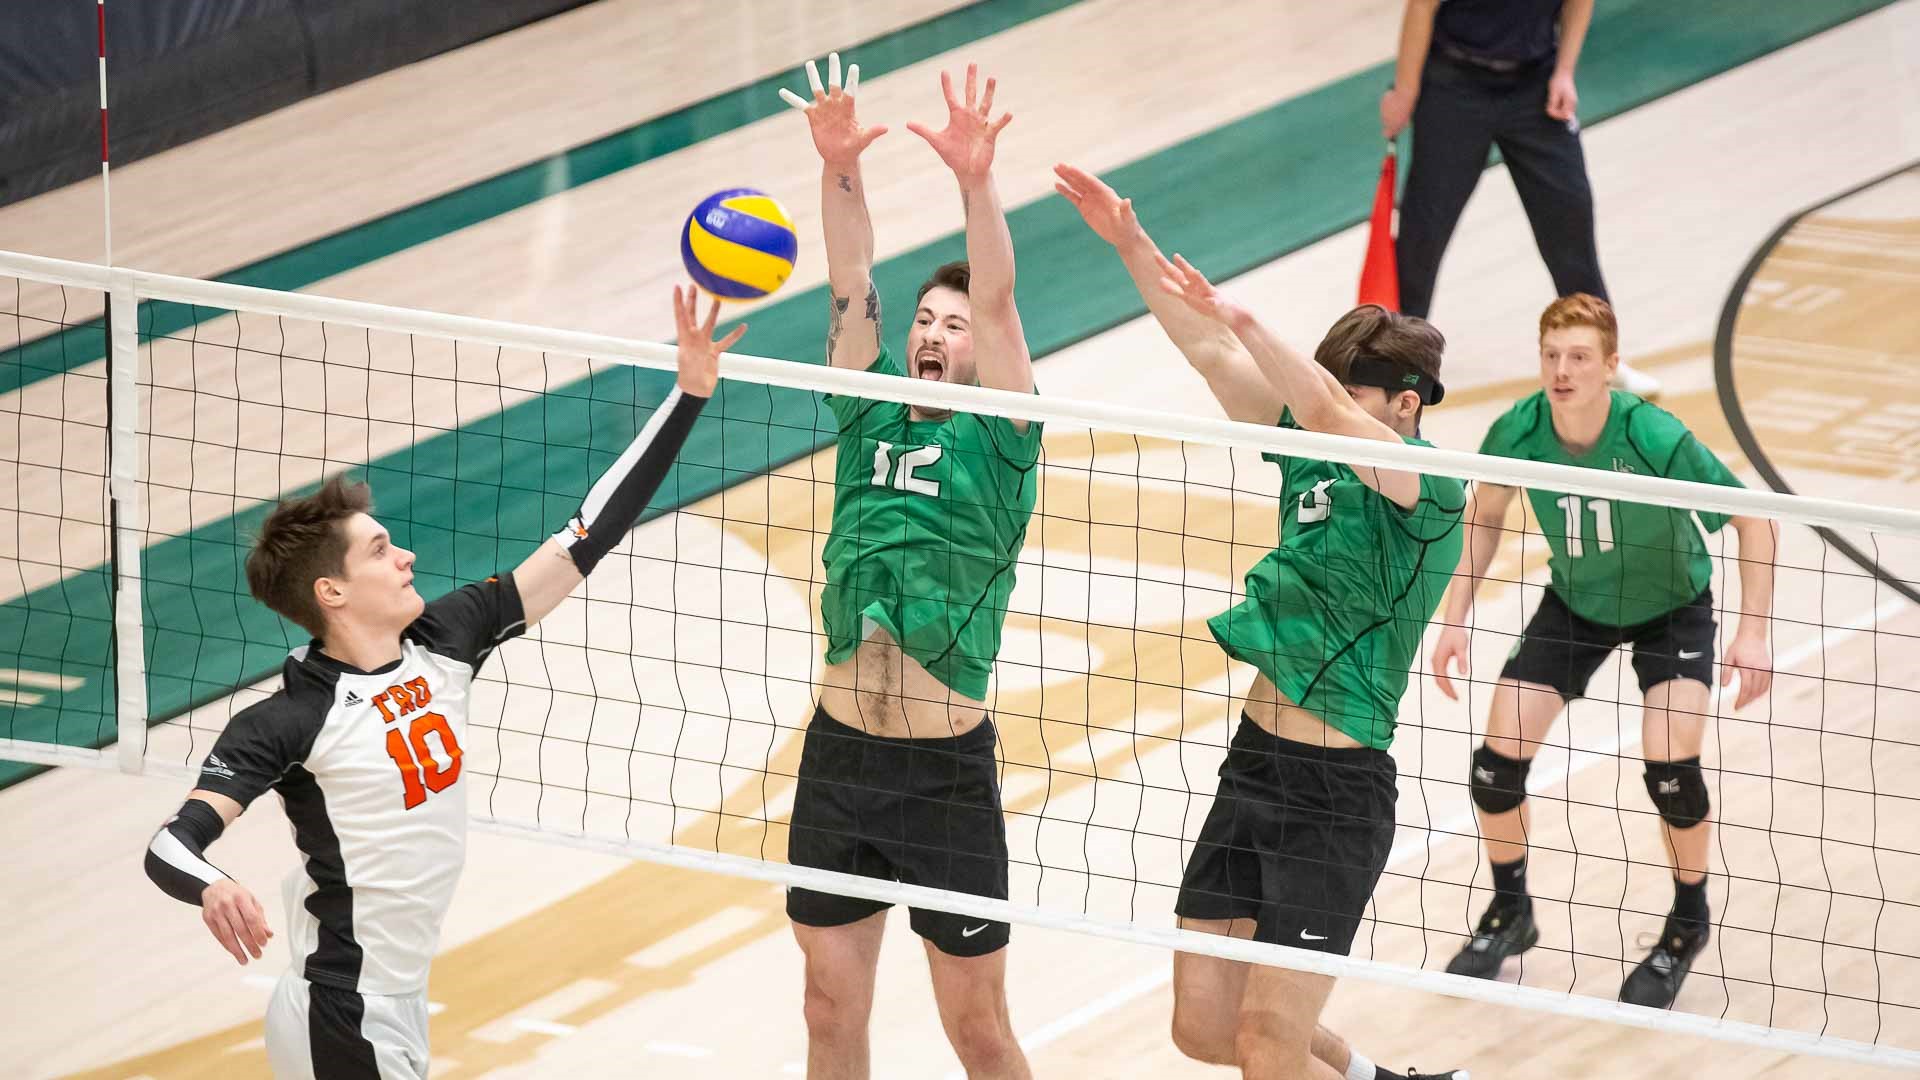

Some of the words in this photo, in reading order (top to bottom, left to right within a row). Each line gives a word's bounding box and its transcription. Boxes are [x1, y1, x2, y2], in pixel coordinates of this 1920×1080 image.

[871, 440, 942, 497] 12
[1556, 495, 1615, 558] 11
[386, 711, 464, 810] 10
